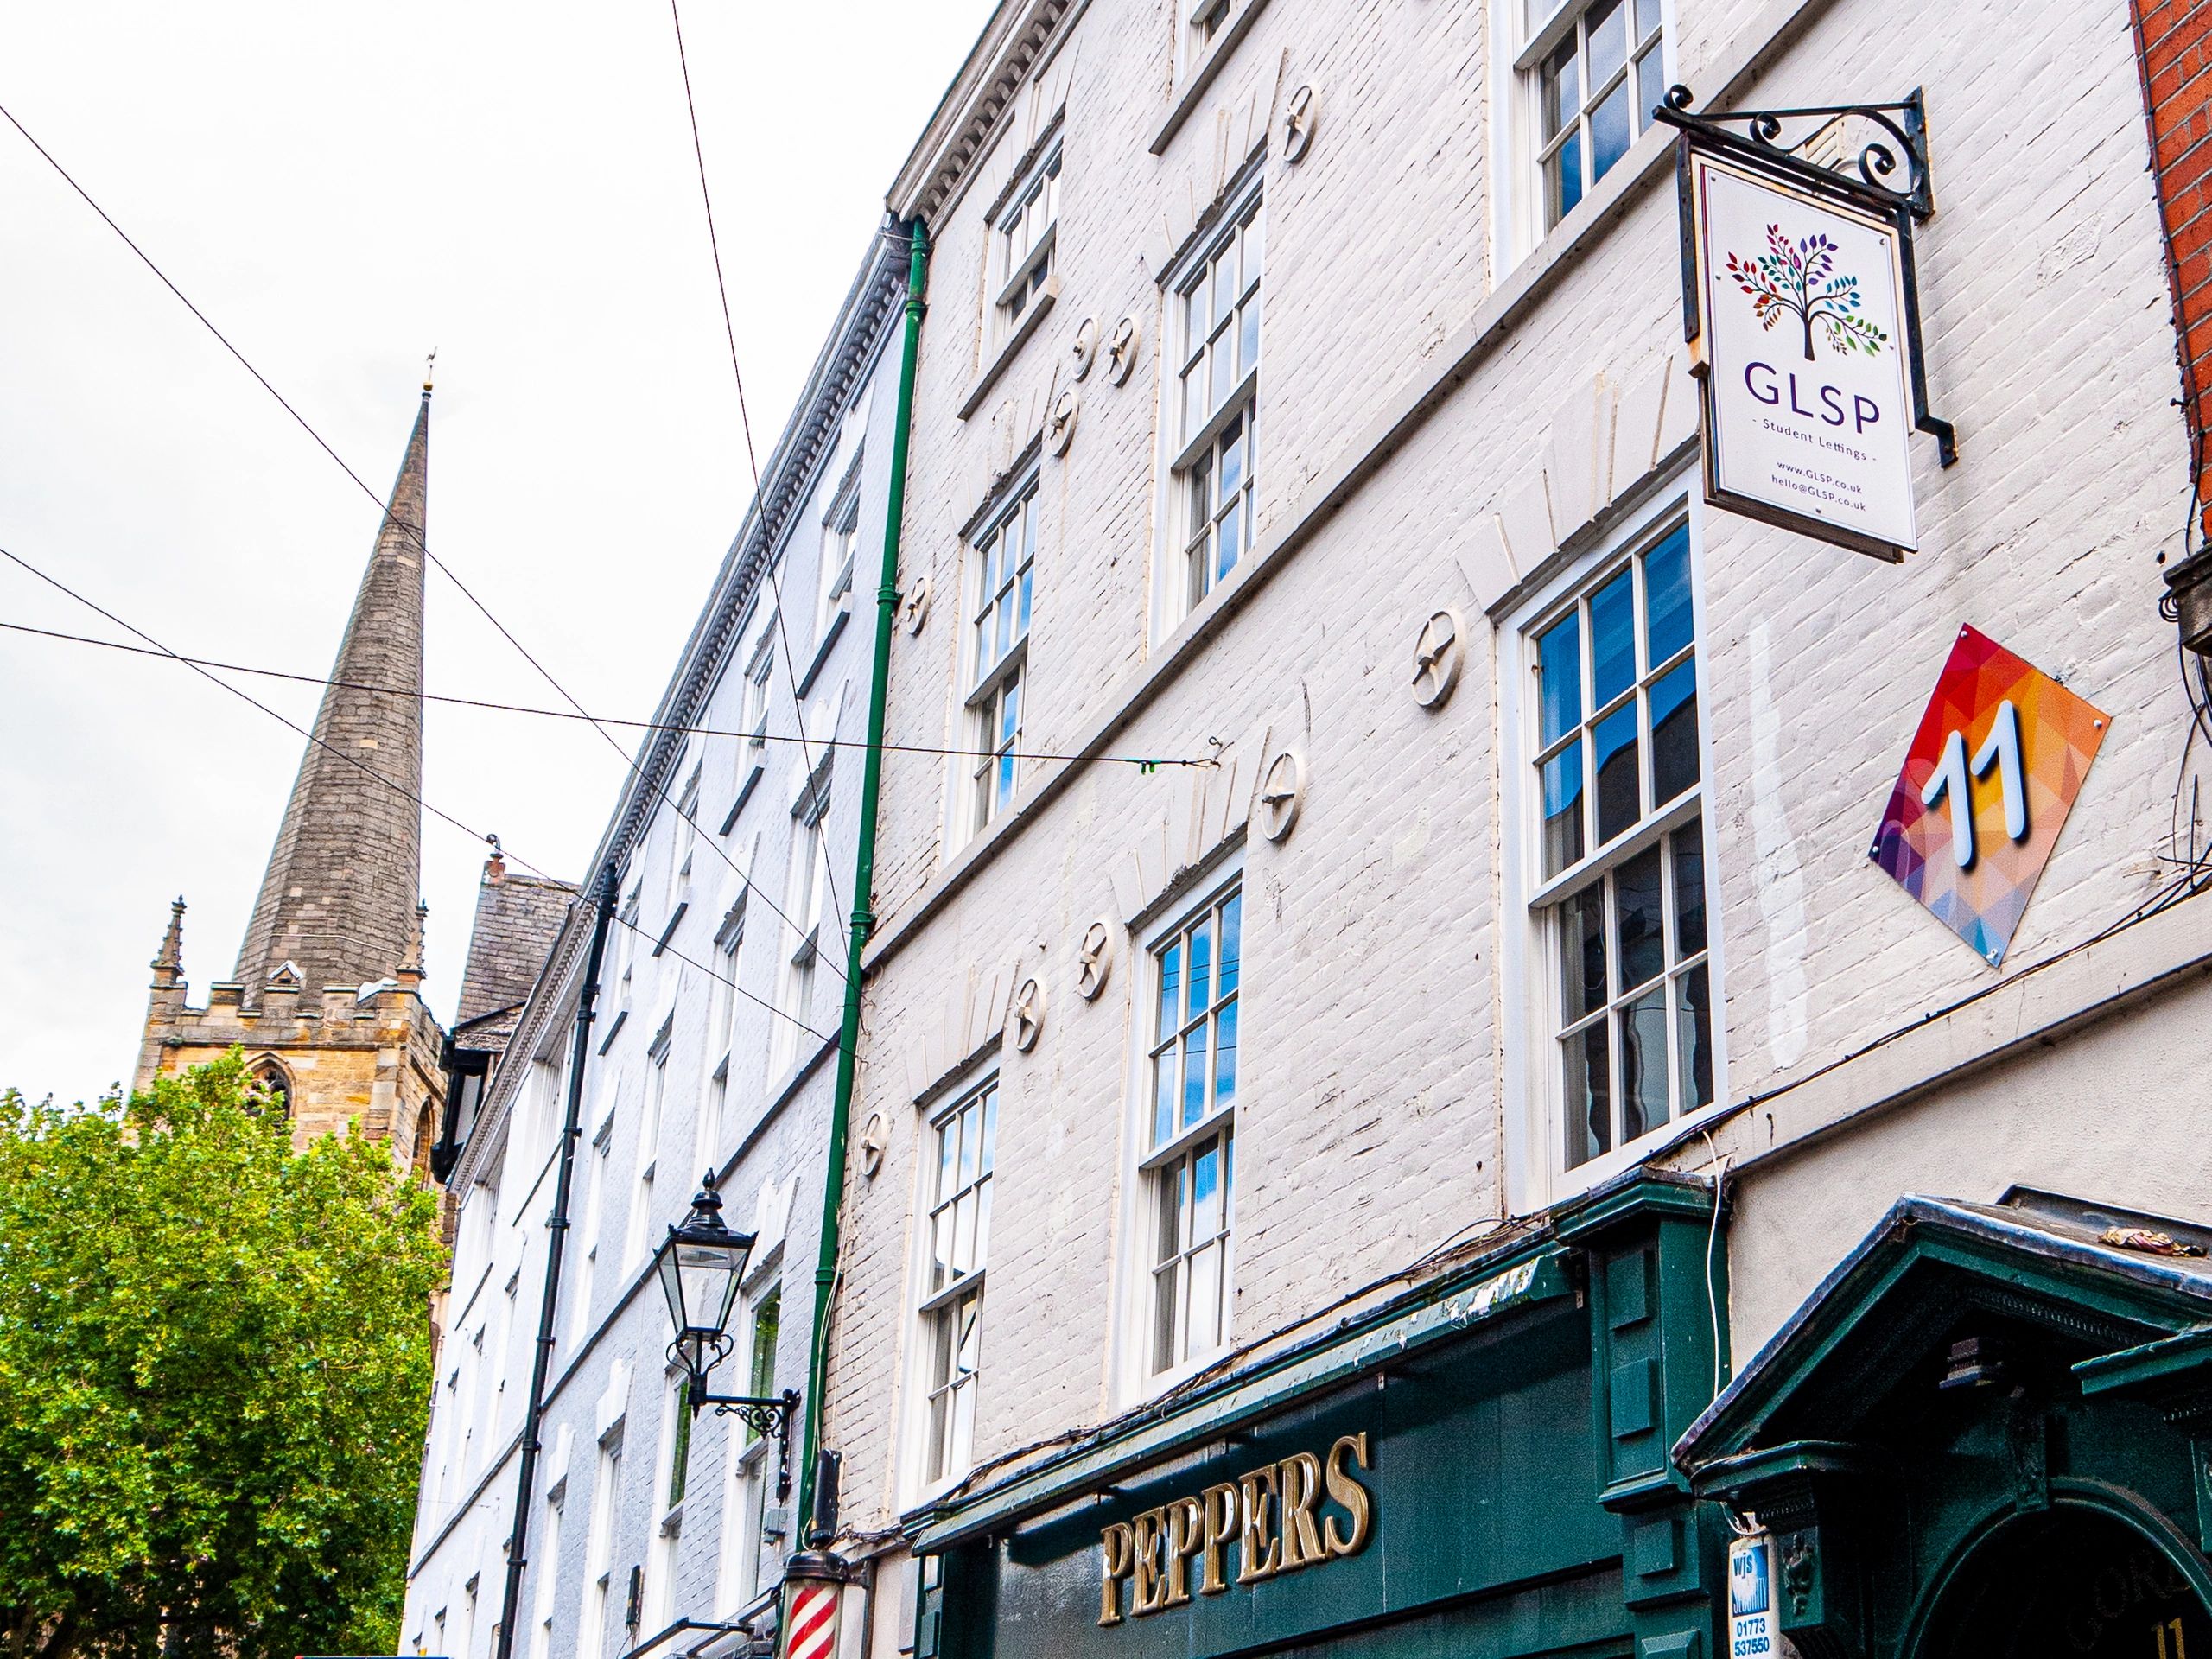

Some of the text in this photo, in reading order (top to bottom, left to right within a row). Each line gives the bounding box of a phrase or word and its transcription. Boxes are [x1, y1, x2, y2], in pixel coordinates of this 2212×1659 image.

[1745, 361, 1879, 434] GLSP
[1763, 418, 1866, 461] Student Lettings
[1771, 474, 1866, 512] hello@GLSP.co.uk
[1777, 461, 1862, 493] www.GLSP.co.uk
[1921, 699, 2025, 868] 11
[1096, 1431, 1370, 1628] PEPPERS
[1734, 1637, 1770, 1657] 537550
[1737, 1618, 1765, 1637] 01773
